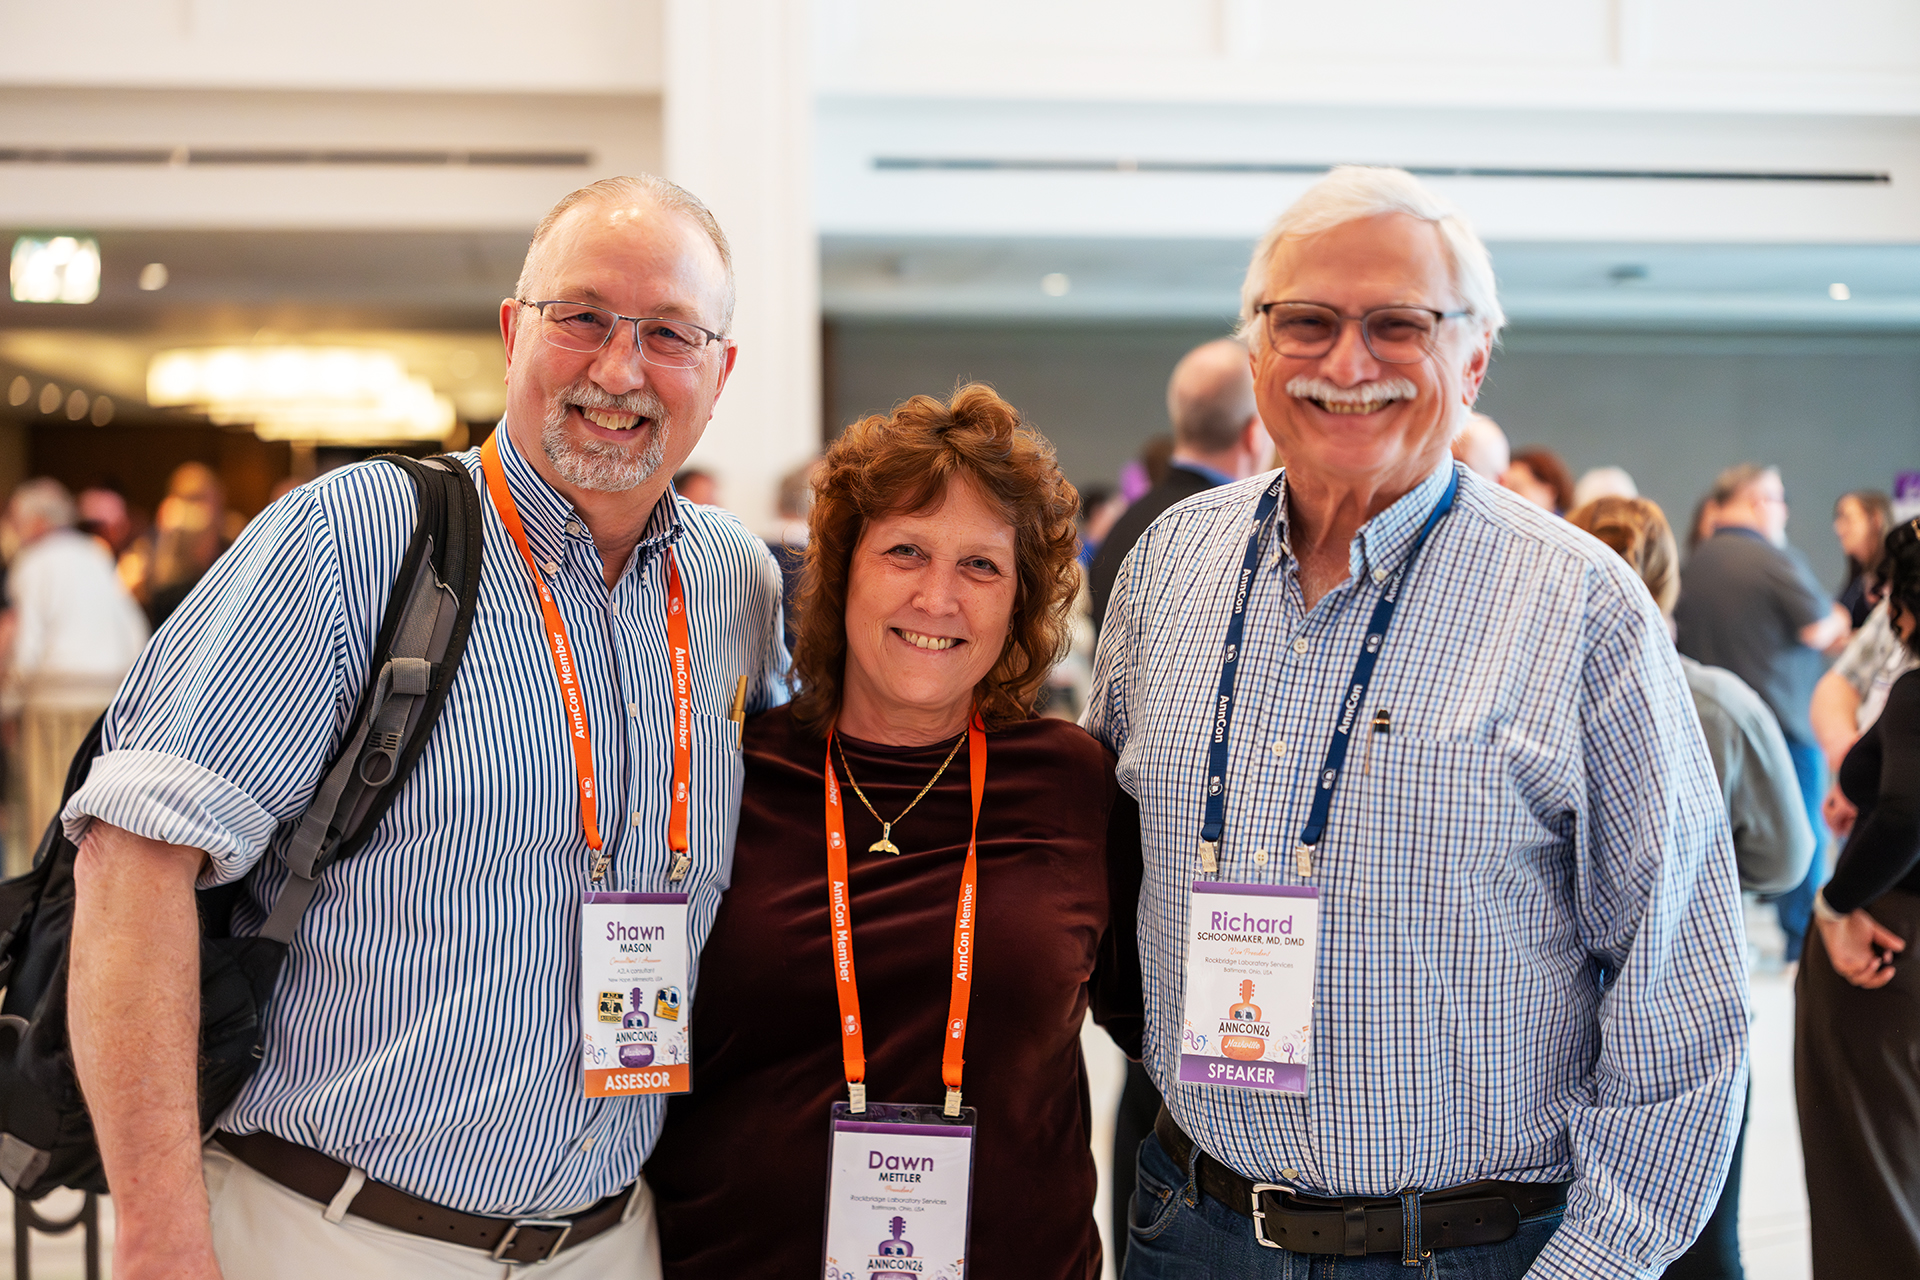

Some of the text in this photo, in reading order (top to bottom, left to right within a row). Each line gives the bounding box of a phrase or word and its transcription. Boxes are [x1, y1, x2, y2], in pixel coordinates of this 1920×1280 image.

[1235, 568, 1251, 614] AnnCon
[554, 632, 585, 739] AnnCon Member
[675, 647, 689, 750] AnnCon Member
[1214, 695, 1230, 743] AnnCon
[1338, 684, 1363, 735] AnnCon
[606, 921, 665, 941] Shawn
[833, 881, 850, 982] AnnCon Member
[956, 883, 973, 981] AnnCon Member
[1211, 911, 1293, 935] Richard
[620, 943, 652, 953] MASON
[1197, 931, 1305, 947] SCHOONMAKER, MD, DMD
[1205, 957, 1294, 969] Rockbridge Laboratory Services
[615, 1030, 658, 1044] ANNCON26
[1218, 1021, 1271, 1038] ANNCON26
[1224, 1038, 1261, 1050] Nashville
[604, 1072, 670, 1091] ASSESSOR
[1207, 1062, 1275, 1084] SPEAKER
[868, 1150, 934, 1172] Dawn
[878, 1172, 922, 1183] METTLER
[850, 1194, 886, 1203] Rockbridge
[887, 1197, 920, 1205] Laboratory
[867, 1259, 923, 1272] ANNCON26
